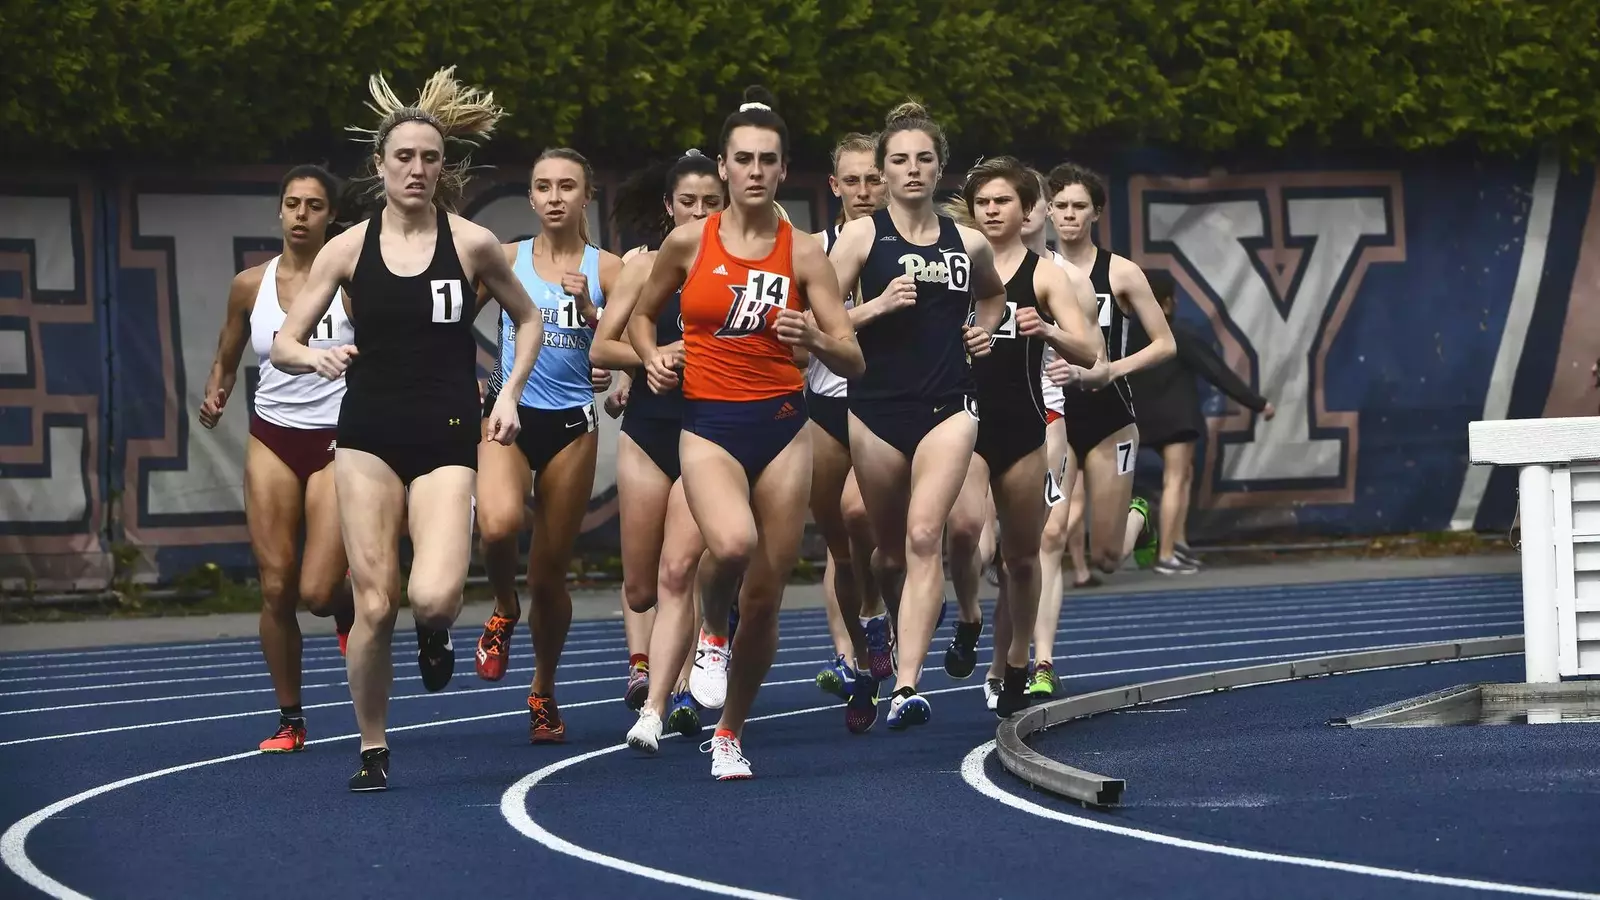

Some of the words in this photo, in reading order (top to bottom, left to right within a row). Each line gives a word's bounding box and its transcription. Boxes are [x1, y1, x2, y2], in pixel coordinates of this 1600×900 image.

[898, 253, 949, 283] Pitt
[950, 255, 967, 288] 6
[437, 283, 452, 320] 1
[753, 273, 784, 305] 14
[1119, 443, 1132, 472] 7
